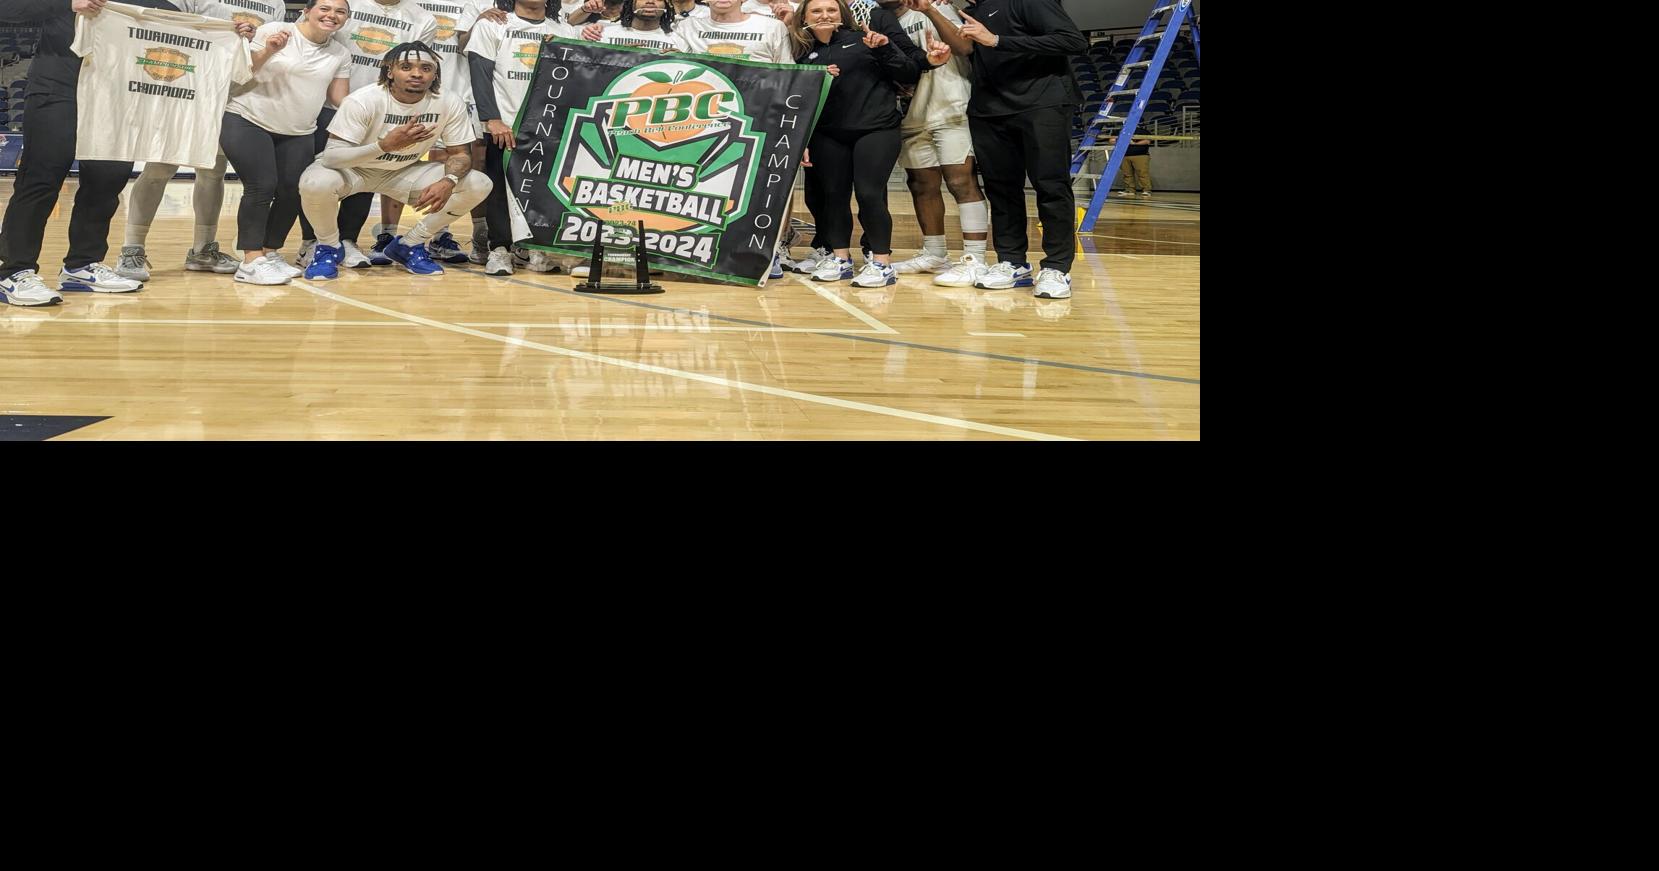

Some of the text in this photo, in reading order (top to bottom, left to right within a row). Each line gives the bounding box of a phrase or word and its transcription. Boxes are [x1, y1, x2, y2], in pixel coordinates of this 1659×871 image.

[128, 26, 213, 51] TOURNAMENT
[698, 30, 765, 41] TOURNAMENT
[128, 80, 196, 100] CHAMPIONS
[608, 90, 736, 129] PBC
[616, 157, 695, 188] MEN'S
[749, 94, 802, 249] CHAMPION
[574, 180, 722, 225] BASKETBALL
[561, 215, 714, 263] 2023-2024
